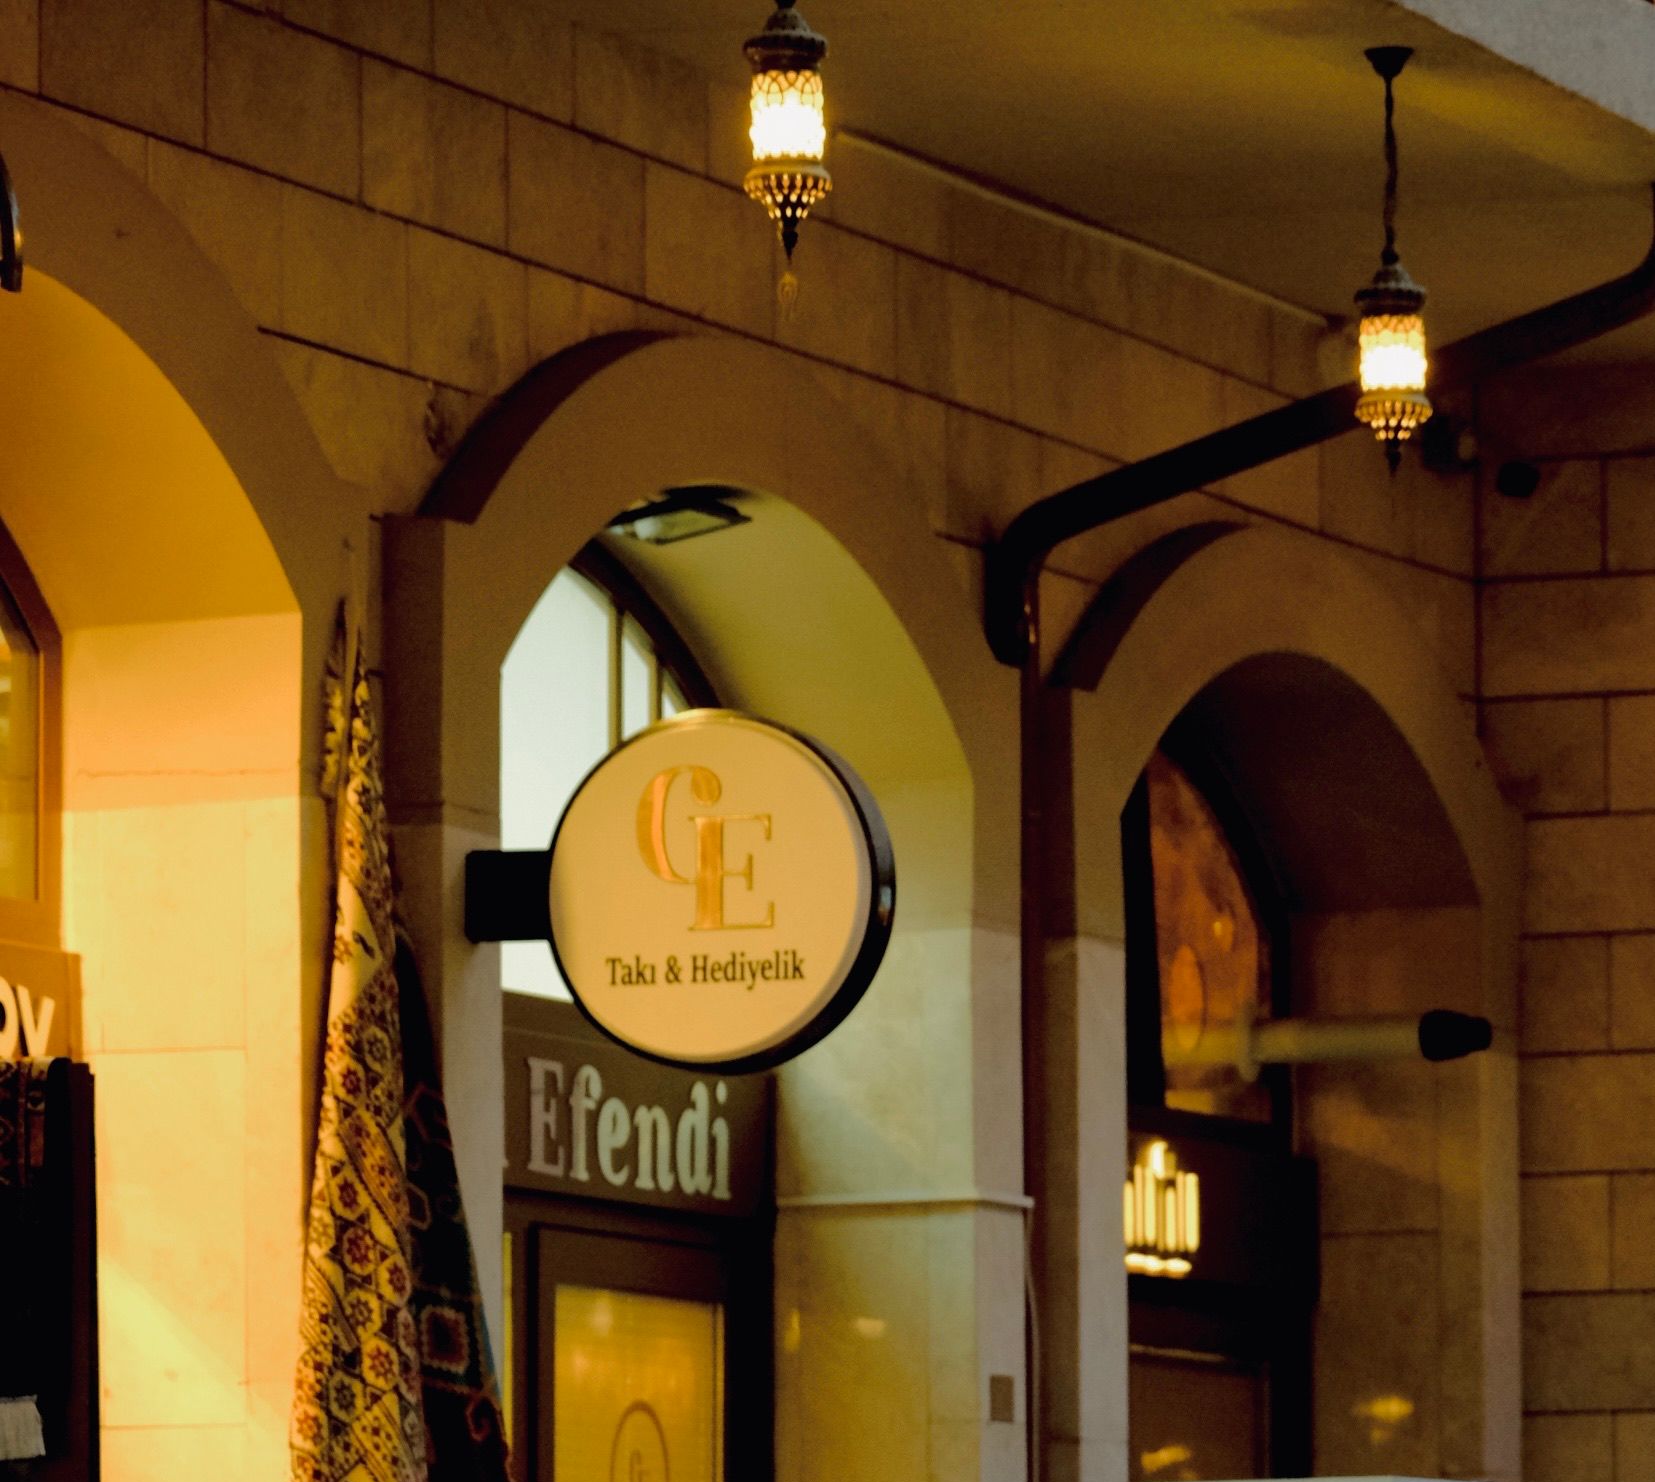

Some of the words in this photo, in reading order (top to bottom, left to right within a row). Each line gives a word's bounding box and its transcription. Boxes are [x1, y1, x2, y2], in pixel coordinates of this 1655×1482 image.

[605, 954, 657, 986] Takı
[664, 954, 682, 984] &
[691, 950, 806, 991] Hediyelik
[527, 1056, 733, 1201] Efendi
